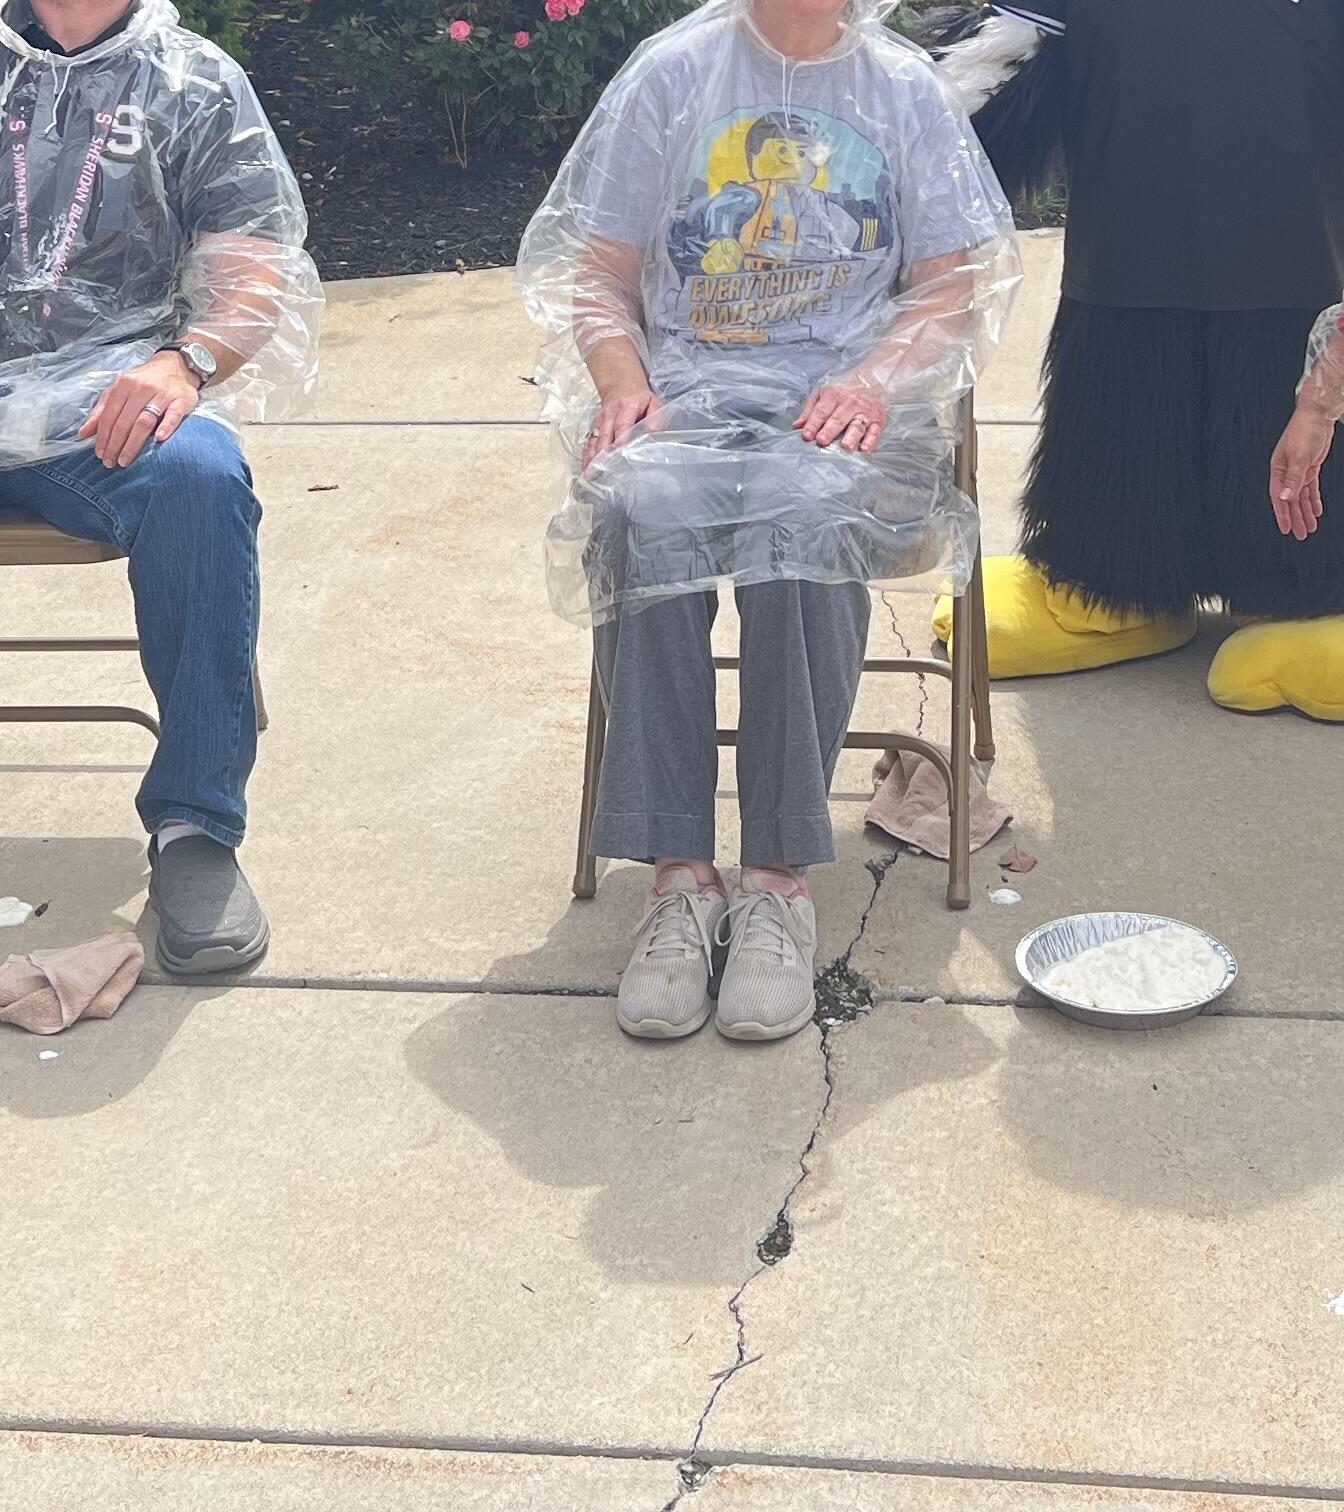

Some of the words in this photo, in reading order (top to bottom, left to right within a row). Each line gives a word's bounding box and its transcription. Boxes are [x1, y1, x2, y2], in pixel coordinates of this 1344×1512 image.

[12, 143, 28, 229] BLACKHAWKS
[74, 135, 104, 202] SHERIDAN
[690, 265, 824, 304] EVERYTHING
[826, 263, 851, 288] IS
